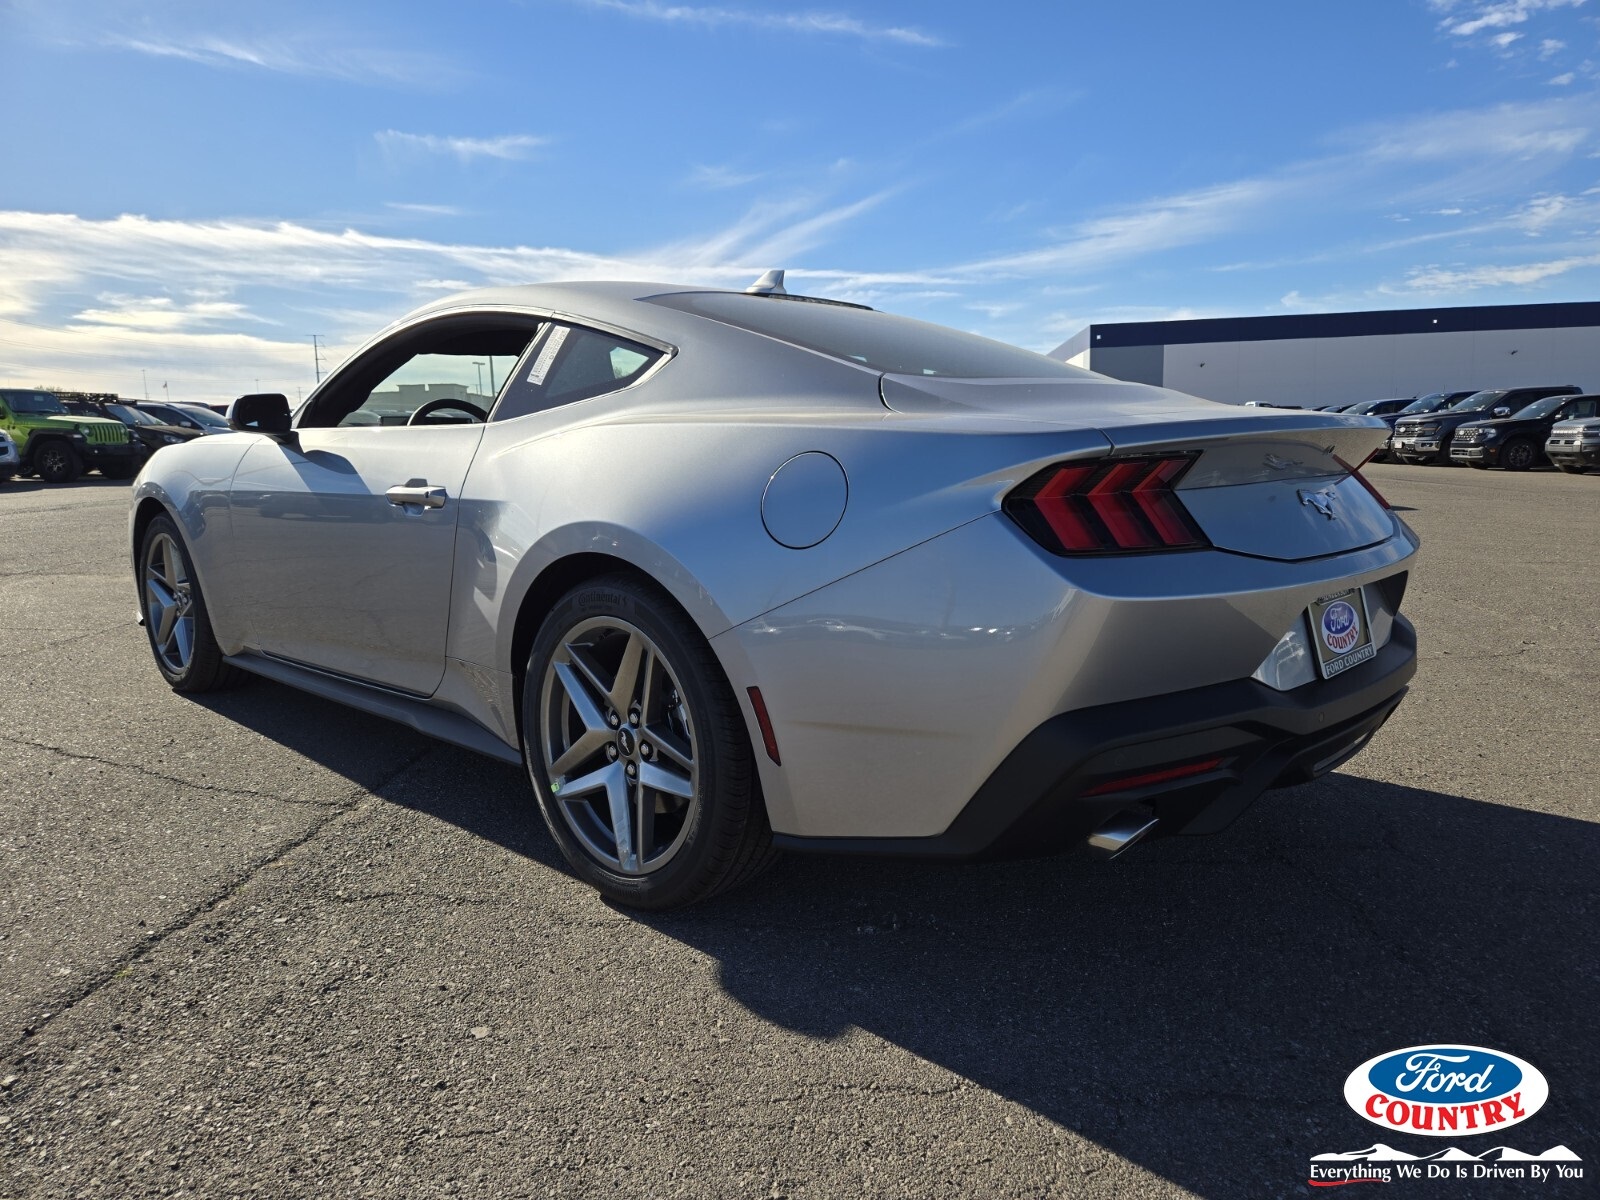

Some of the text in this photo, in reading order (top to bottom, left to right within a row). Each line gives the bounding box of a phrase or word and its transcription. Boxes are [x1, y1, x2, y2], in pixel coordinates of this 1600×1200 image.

[579, 592, 620, 605] Continental
[1330, 608, 1349, 631] Ford
[1327, 624, 1358, 649] COUNTRY
[1326, 646, 1373, 675] FORD COUNTRY
